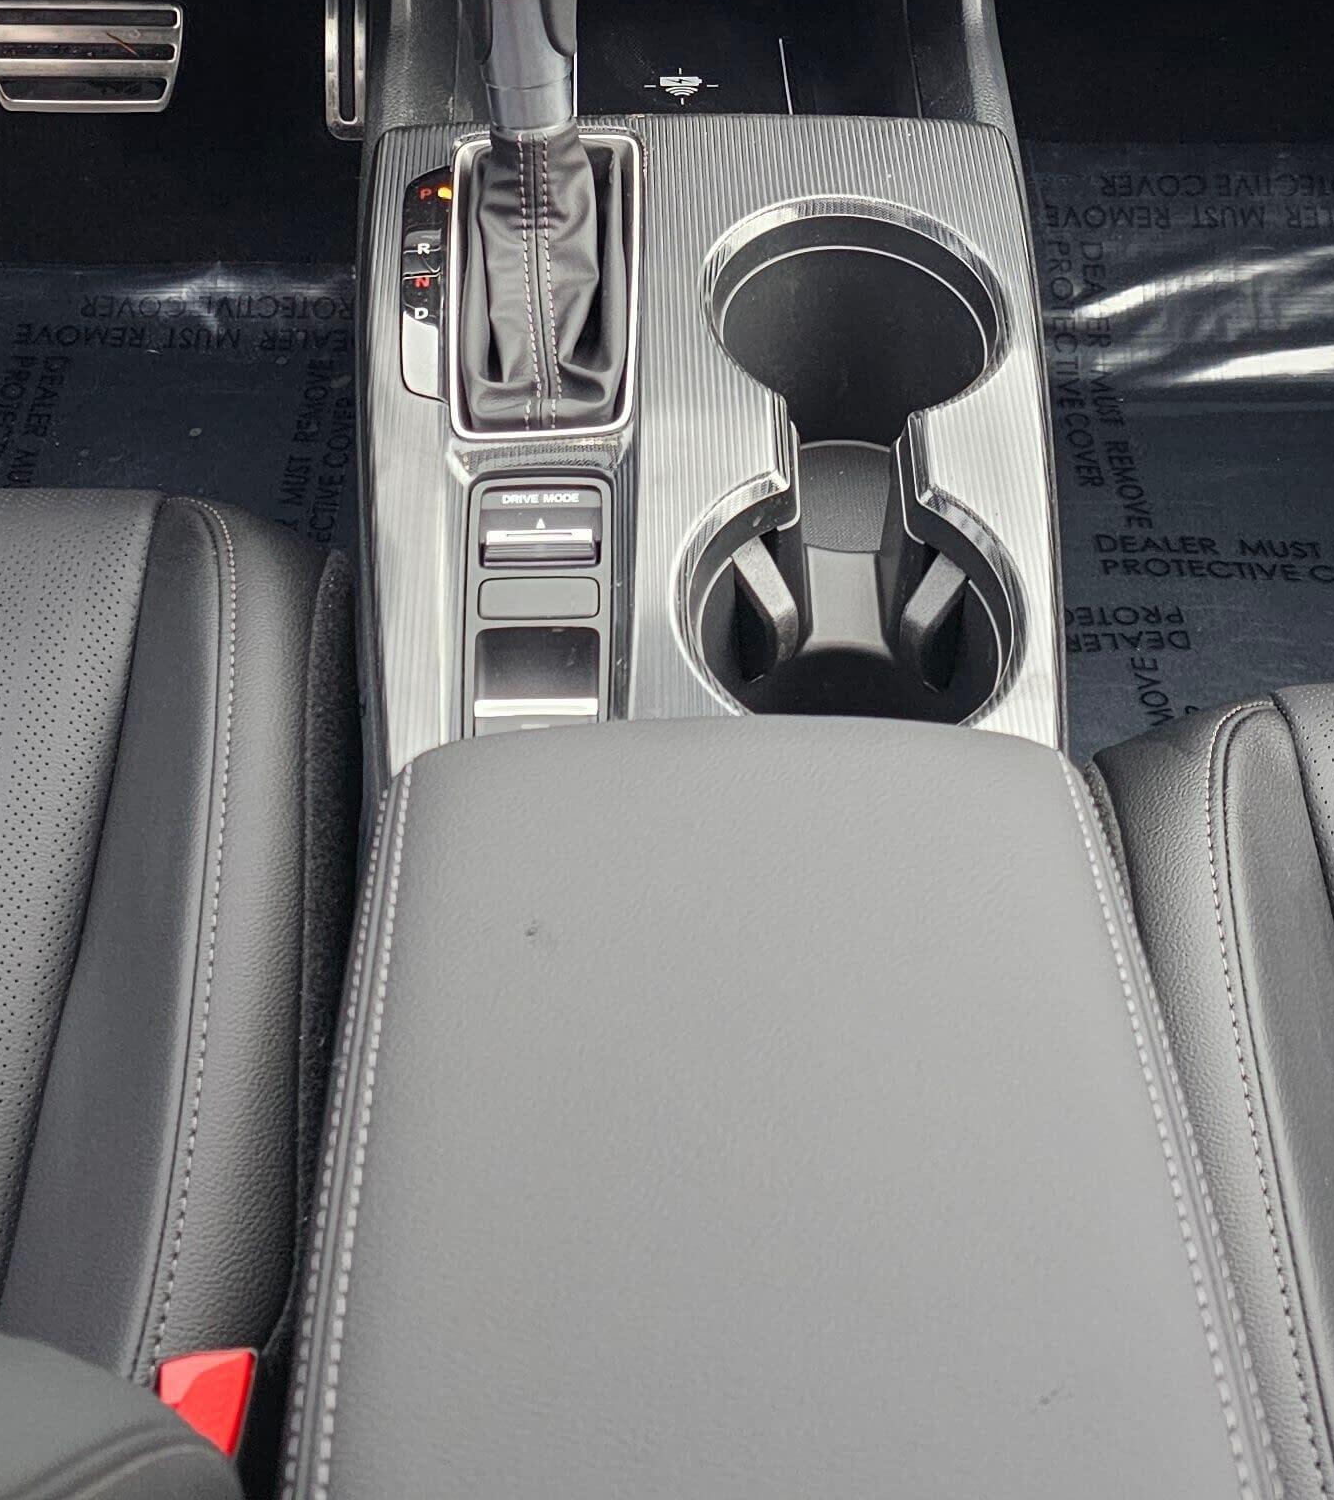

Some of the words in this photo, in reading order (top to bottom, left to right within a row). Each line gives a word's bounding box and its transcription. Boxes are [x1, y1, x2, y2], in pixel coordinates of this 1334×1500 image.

[419, 187, 432, 200] P
[1099, 174, 1209, 198] COVER
[1043, 204, 1171, 230] REMOVE
[1192, 205, 1266, 230] MUST
[417, 242, 431, 255] R
[414, 307, 429, 320] D
[11, 322, 147, 348] REMOVE
[160, 325, 241, 351] MUST
[1063, 413, 1104, 487] COVER
[277, 455, 311, 508] MUST
[1105, 440, 1154, 530] REMOVE
[501, 493, 539, 504] DRIVE
[542, 492, 580, 503] MODE
[1094, 534, 1218, 556] DEALER
[1238, 538, 1321, 559] MUST
[1101, 558, 1302, 582] PROTECTIVE
